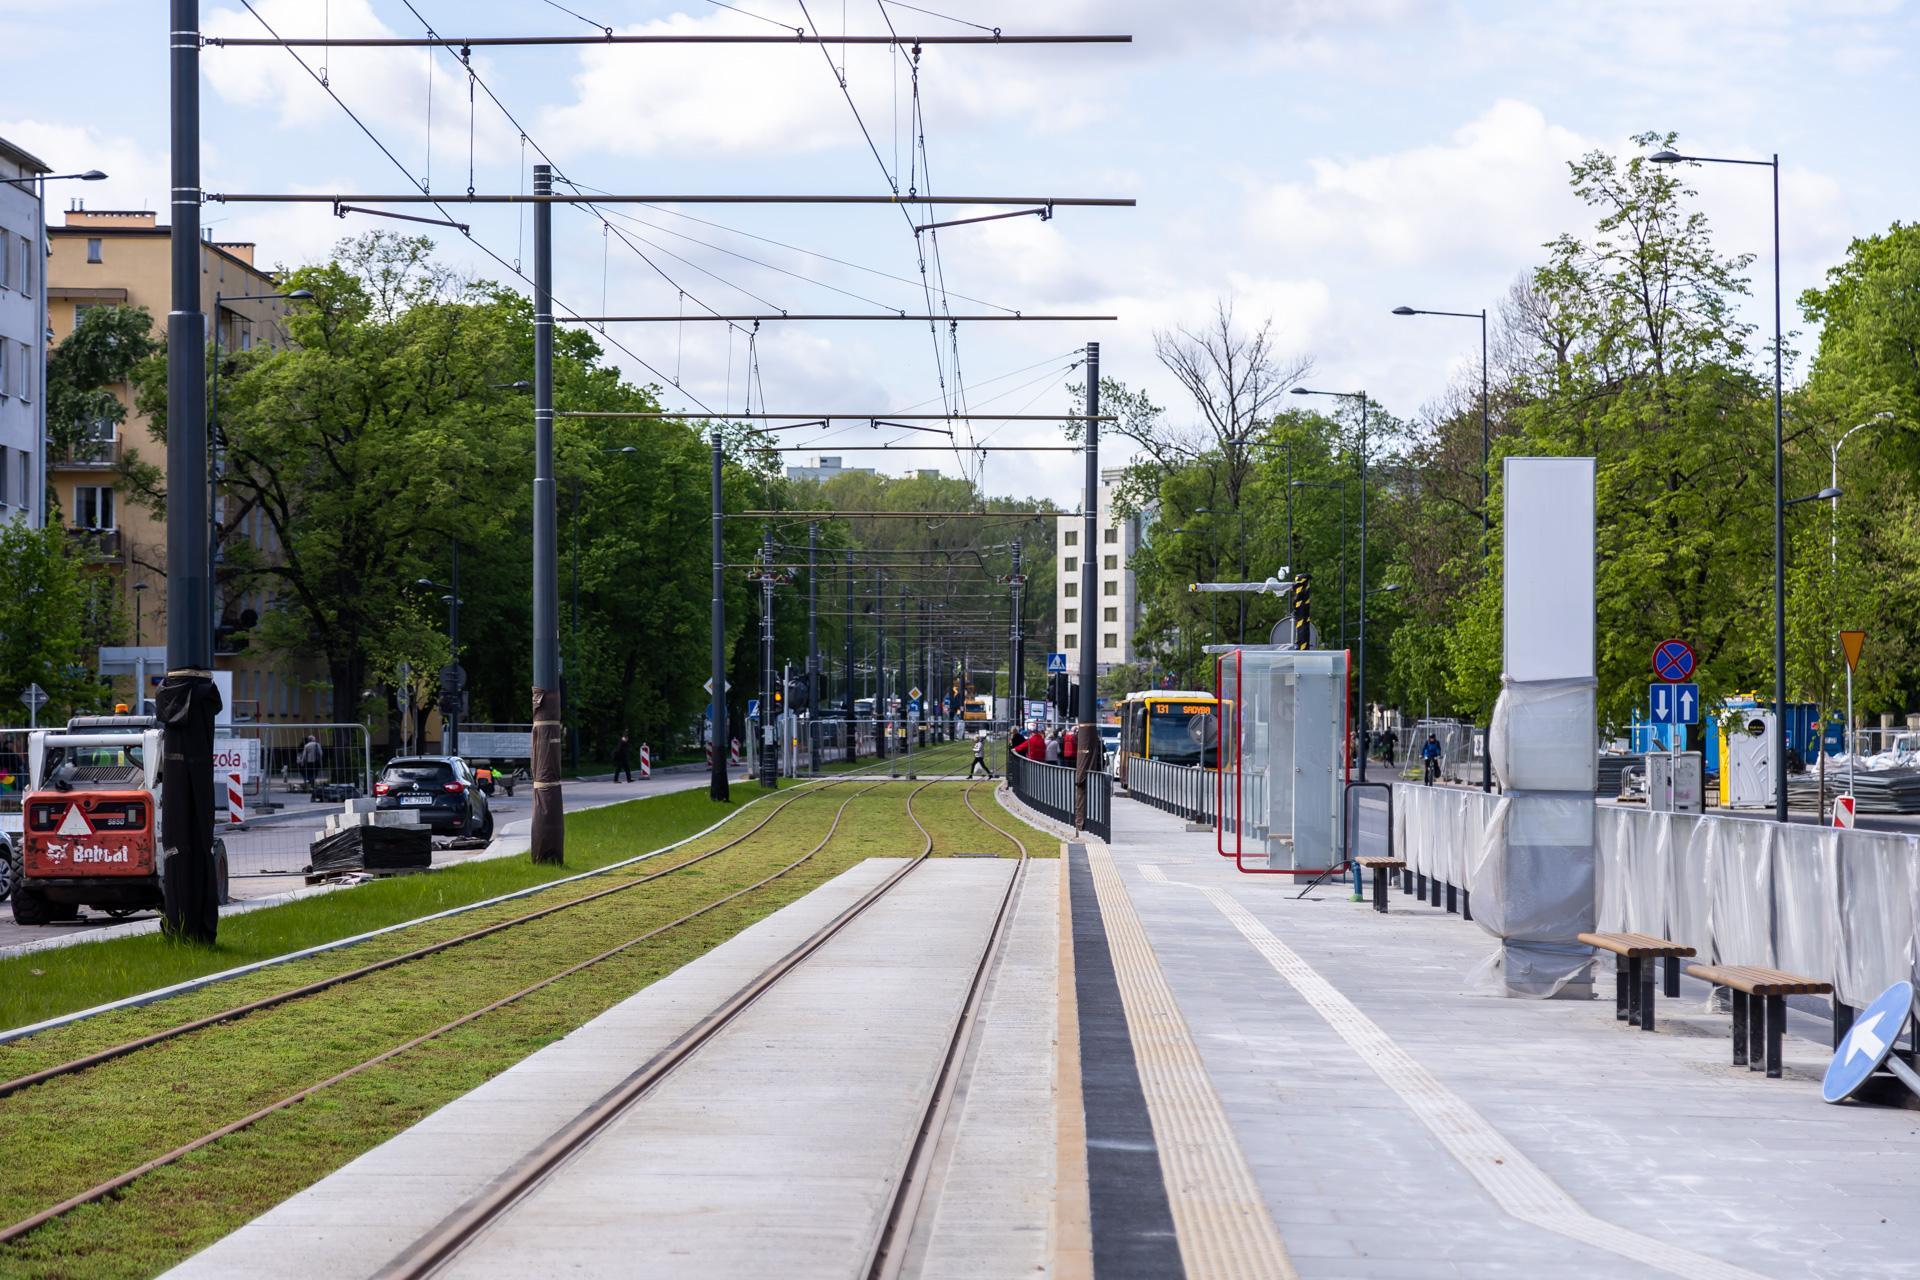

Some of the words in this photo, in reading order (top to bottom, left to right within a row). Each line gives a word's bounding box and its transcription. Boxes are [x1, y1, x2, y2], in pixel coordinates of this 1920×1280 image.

[1156, 704, 1169, 714] 131
[1183, 705, 1211, 715] SADYBA
[73, 845, 129, 862] Bobcat
